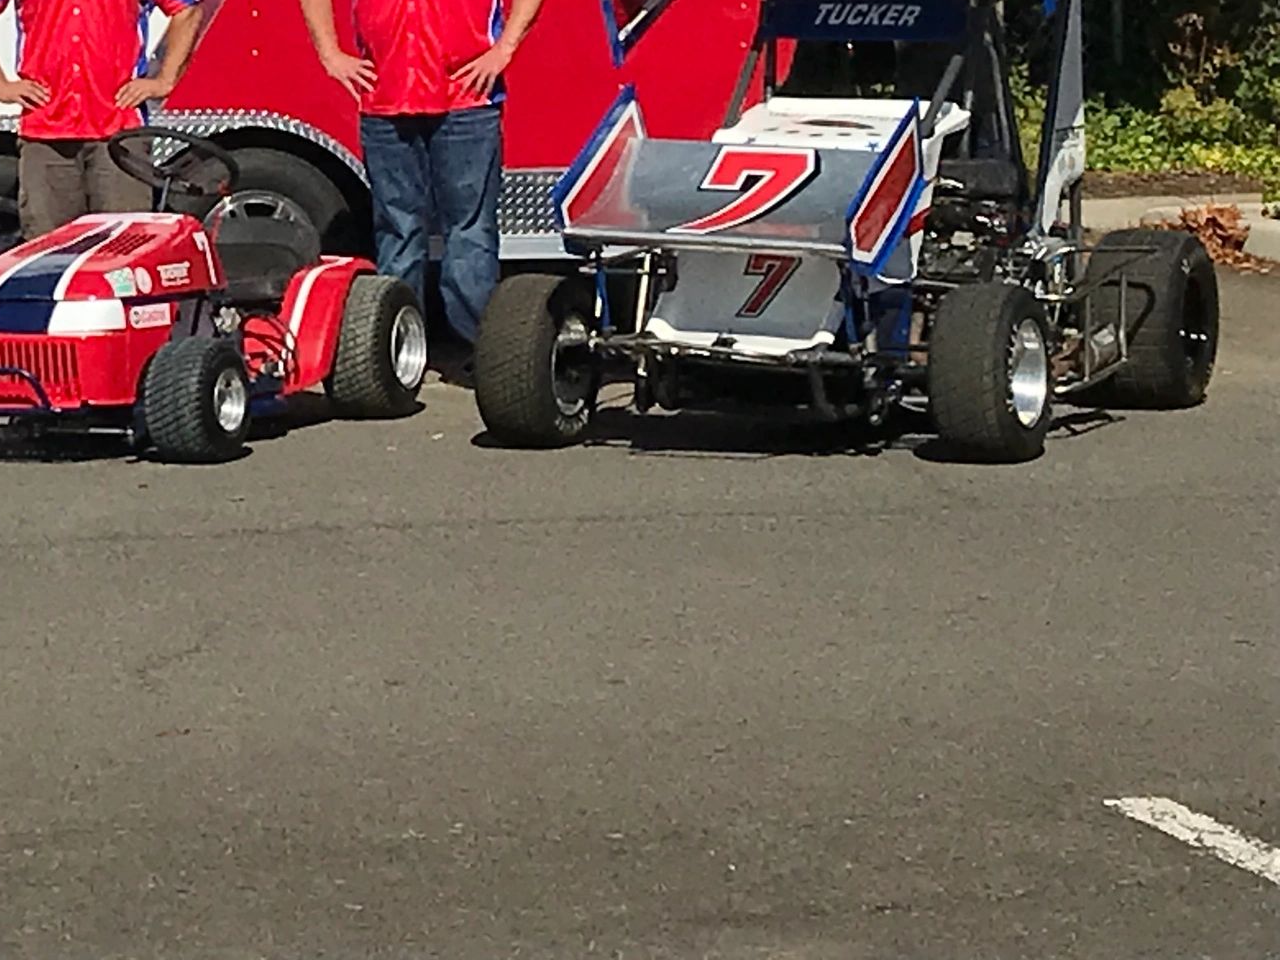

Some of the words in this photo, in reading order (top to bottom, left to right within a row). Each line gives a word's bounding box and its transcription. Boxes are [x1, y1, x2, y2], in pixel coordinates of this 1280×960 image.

[814, 3, 922, 26] TUCKER
[665, 145, 821, 235] 7
[192, 231, 218, 285] 7
[735, 253, 802, 318] 7
